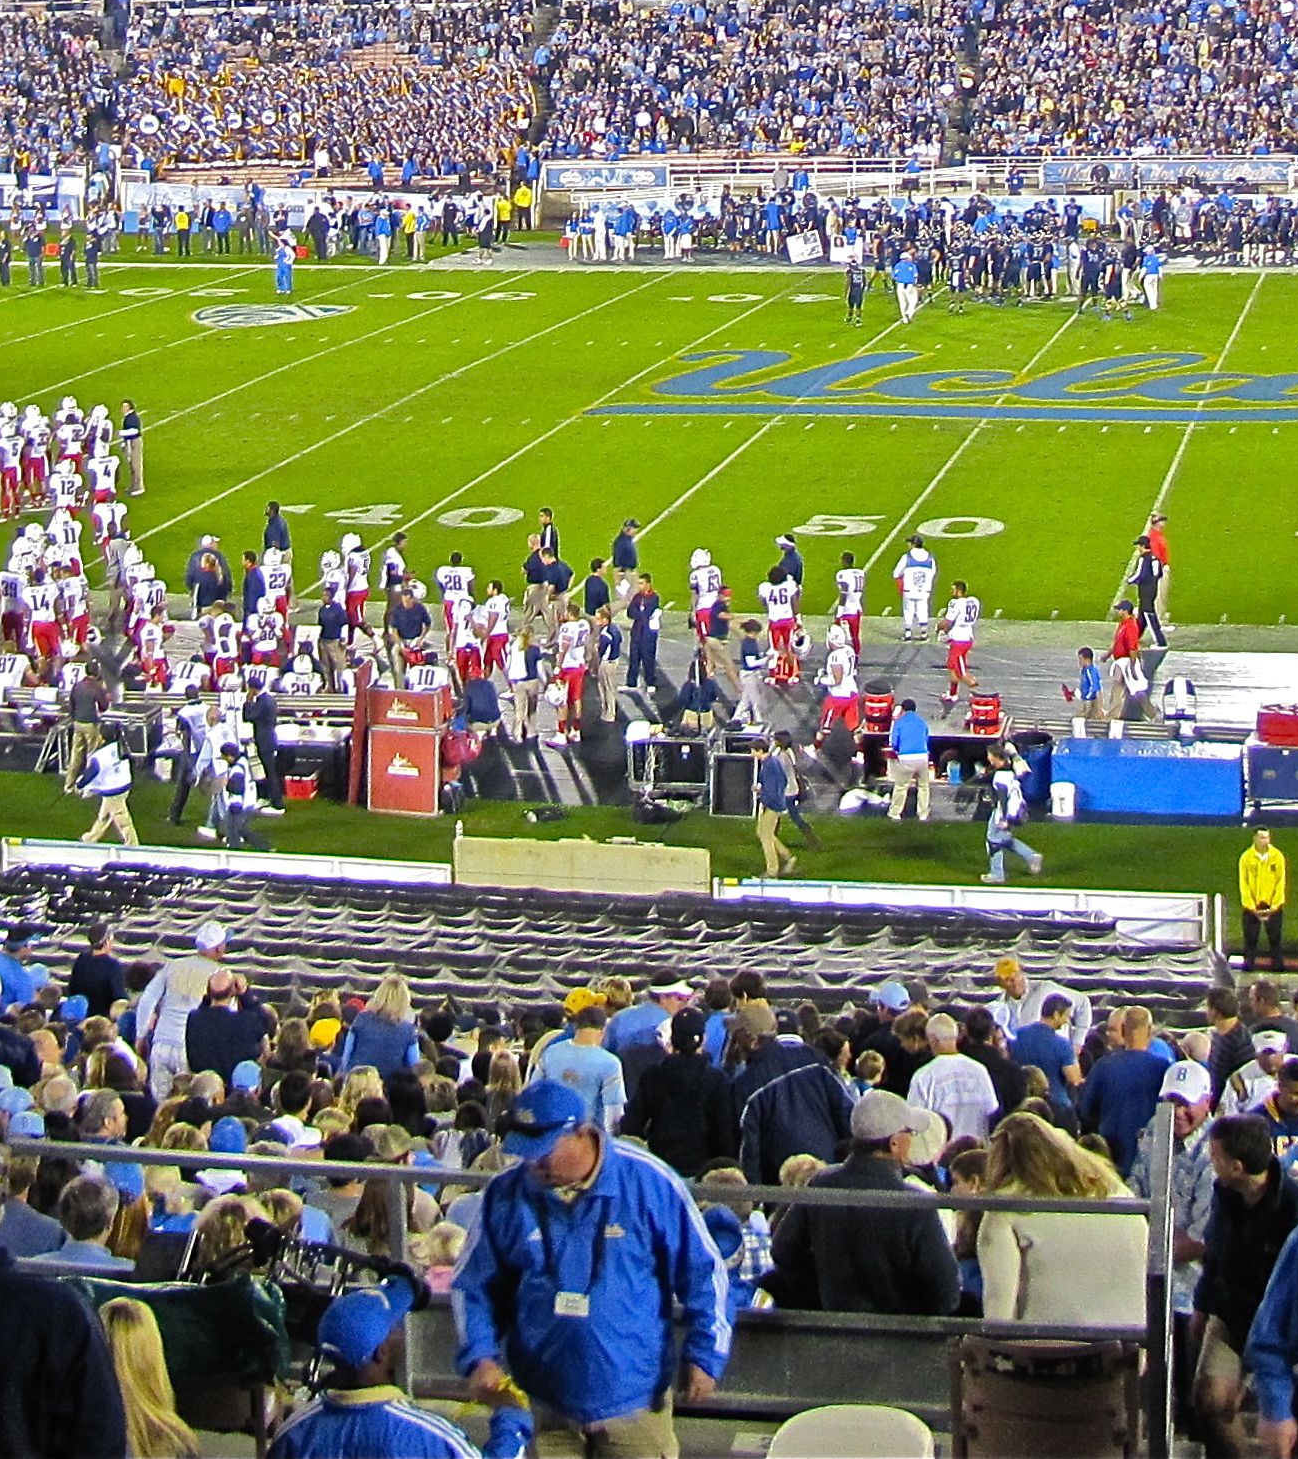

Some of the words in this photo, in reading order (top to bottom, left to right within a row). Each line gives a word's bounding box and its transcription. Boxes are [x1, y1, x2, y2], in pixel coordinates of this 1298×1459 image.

[103, 463, 112, 478] 4
[60, 480, 75, 495] 12
[324, 502, 526, 528] 40
[792, 514, 1008, 540] 50
[63, 528, 76, 544] 11
[268, 573, 286, 589] 23
[444, 574, 462, 591] 28
[31, 593, 49, 611] 14
[768, 588, 788, 605] 46
[69, 667, 80, 684] 3
[179, 663, 193, 679] 11
[417, 669, 435, 686] 10
